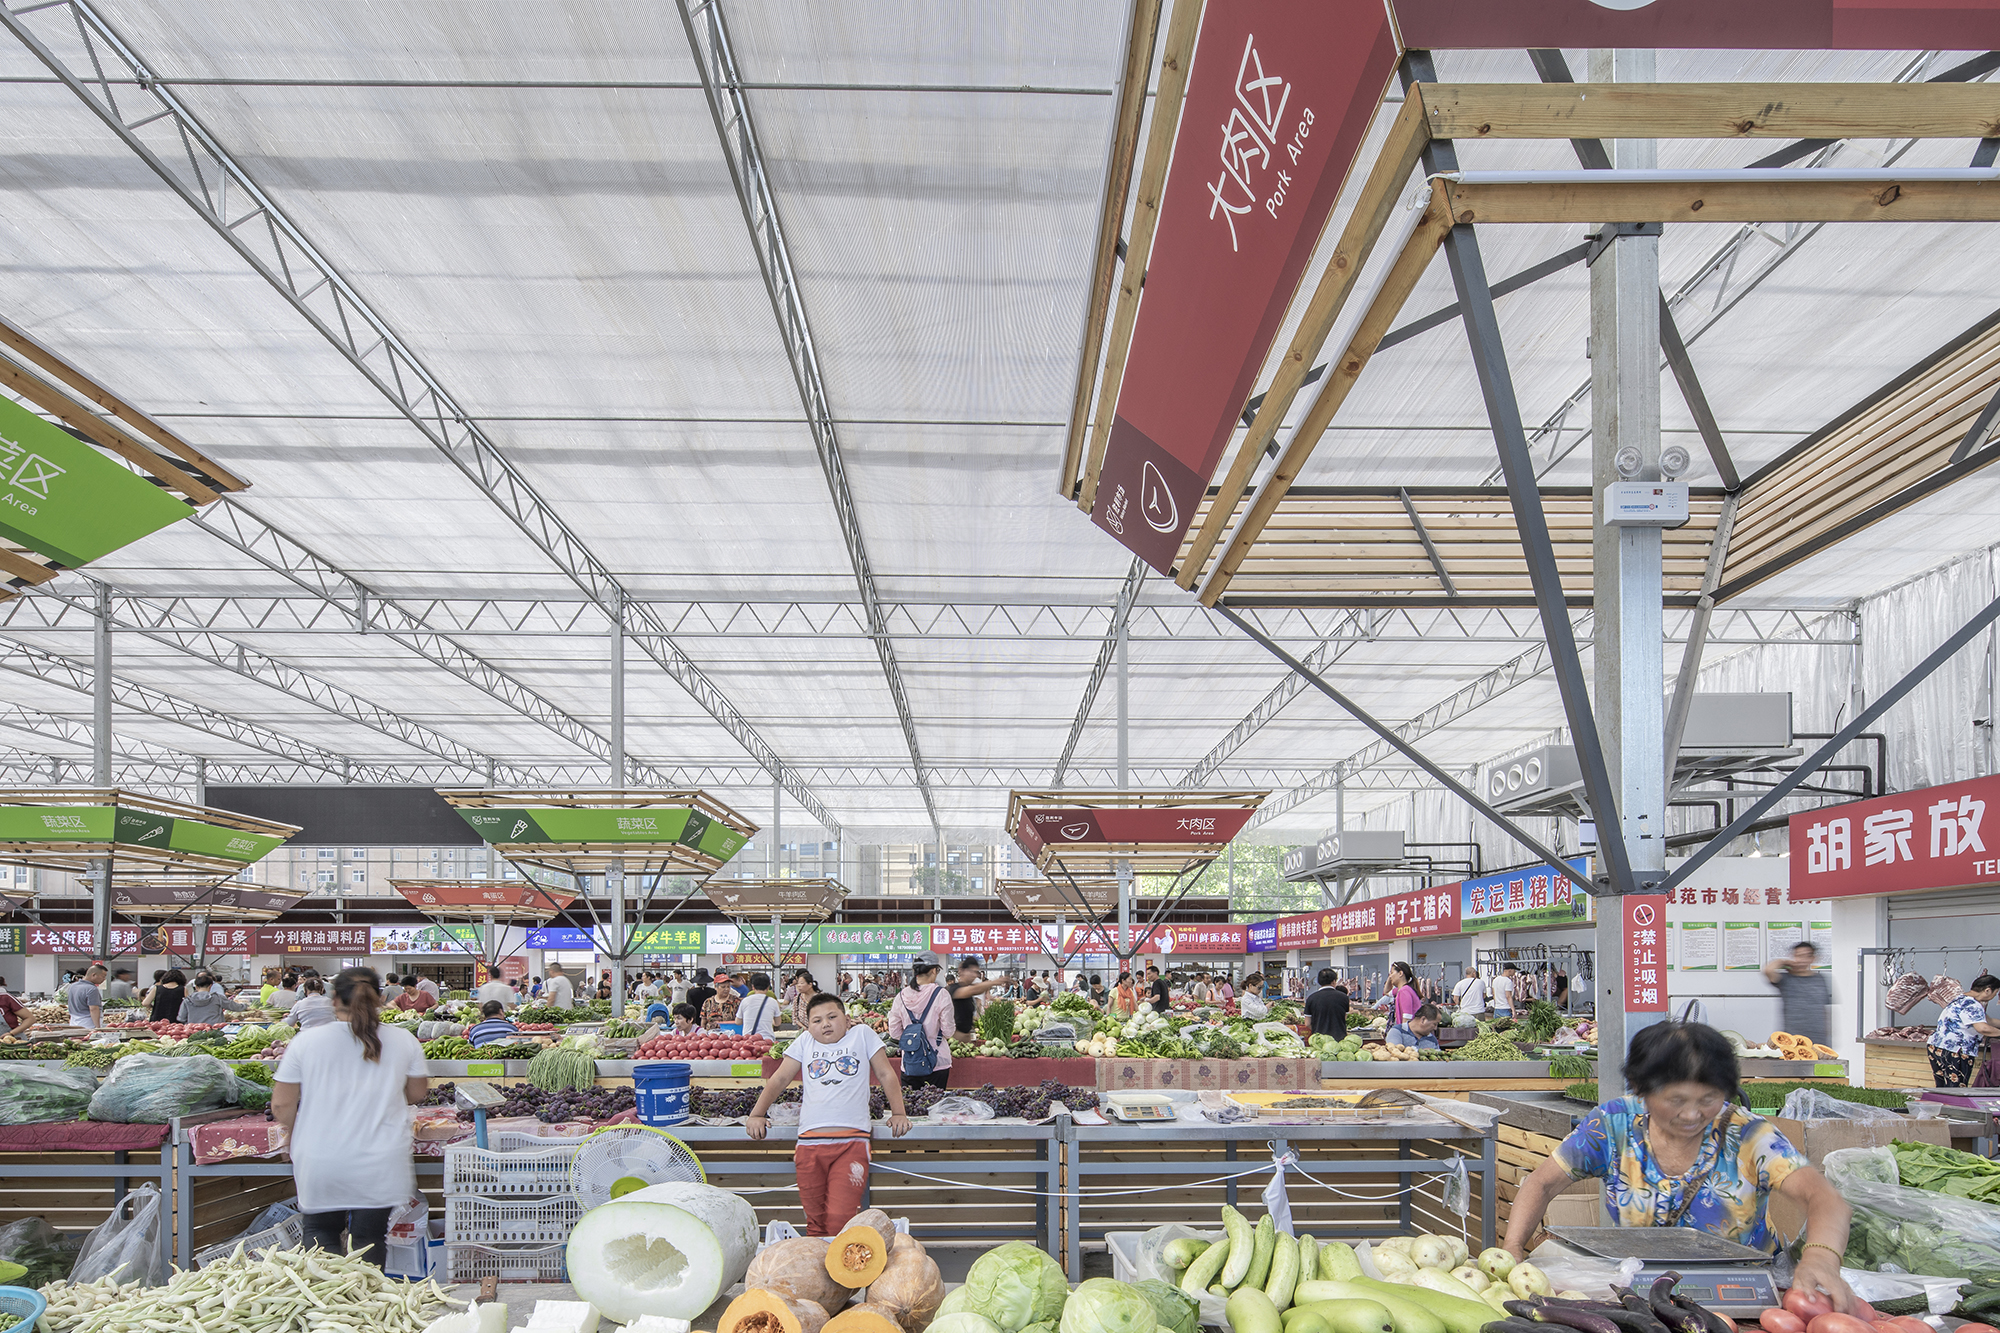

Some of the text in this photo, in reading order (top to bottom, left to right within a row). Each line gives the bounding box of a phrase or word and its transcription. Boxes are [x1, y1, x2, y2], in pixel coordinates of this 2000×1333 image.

[1207, 33, 1291, 252] 大肉区
[1265, 107, 1315, 219] Pork Area
[2, 492, 38, 516] Area
[40, 815, 87, 827] 蔬菜区
[616, 817, 658, 829] 蔬菜区
[1176, 817, 1216, 830] 大肉区
[1807, 794, 1987, 874] 胡家放
[1469, 874, 1574, 915] 宏运黑猪肉
[1330, 906, 1376, 932] 平价生鲜猪肉店
[31, 929, 138, 945] 大名府段香油
[171, 929, 248, 946] 重面条
[260, 930, 366, 944] 一分利粮油调料店
[632, 930, 701, 945] 马家牛羊肉
[826, 929, 923, 944] 传统刘家牛羊肉店
[952, 928, 1039, 944] 马敬牛羊肉
[1178, 932, 1242, 943] 四川鲜面条店
[1640, 929, 1658, 1005] 禁止吸烟
